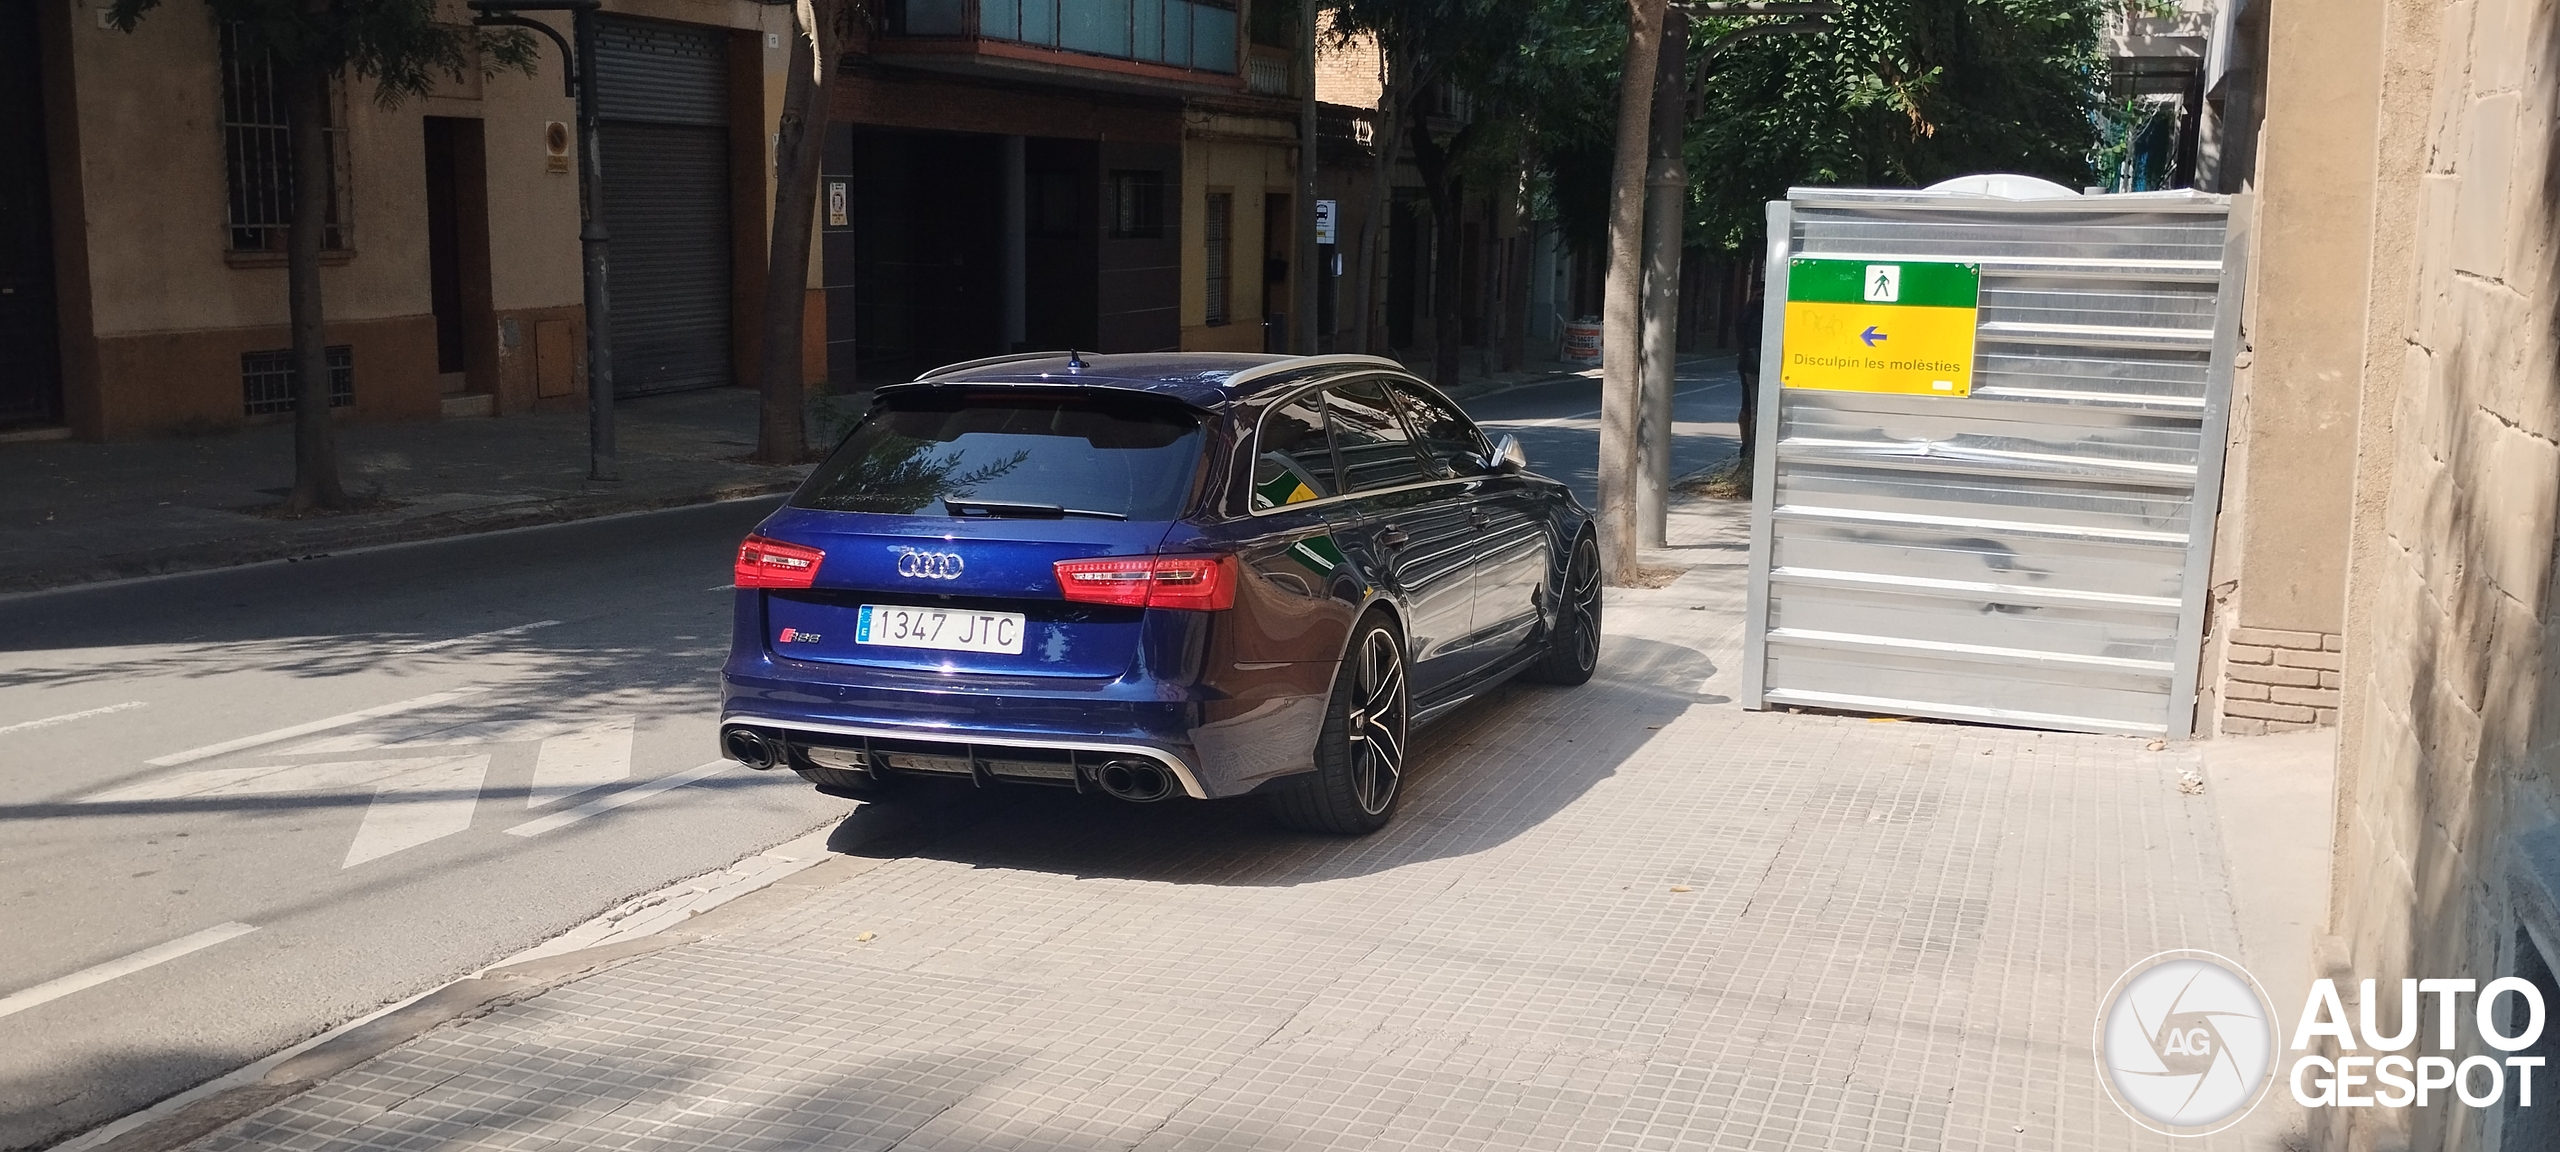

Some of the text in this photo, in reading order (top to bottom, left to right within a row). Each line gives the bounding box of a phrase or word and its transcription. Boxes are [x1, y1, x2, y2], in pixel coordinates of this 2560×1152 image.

[1794, 353, 1961, 373] Disculpin les molèsties
[860, 627, 868, 637] E
[881, 611, 1014, 646] 1347 JTC
